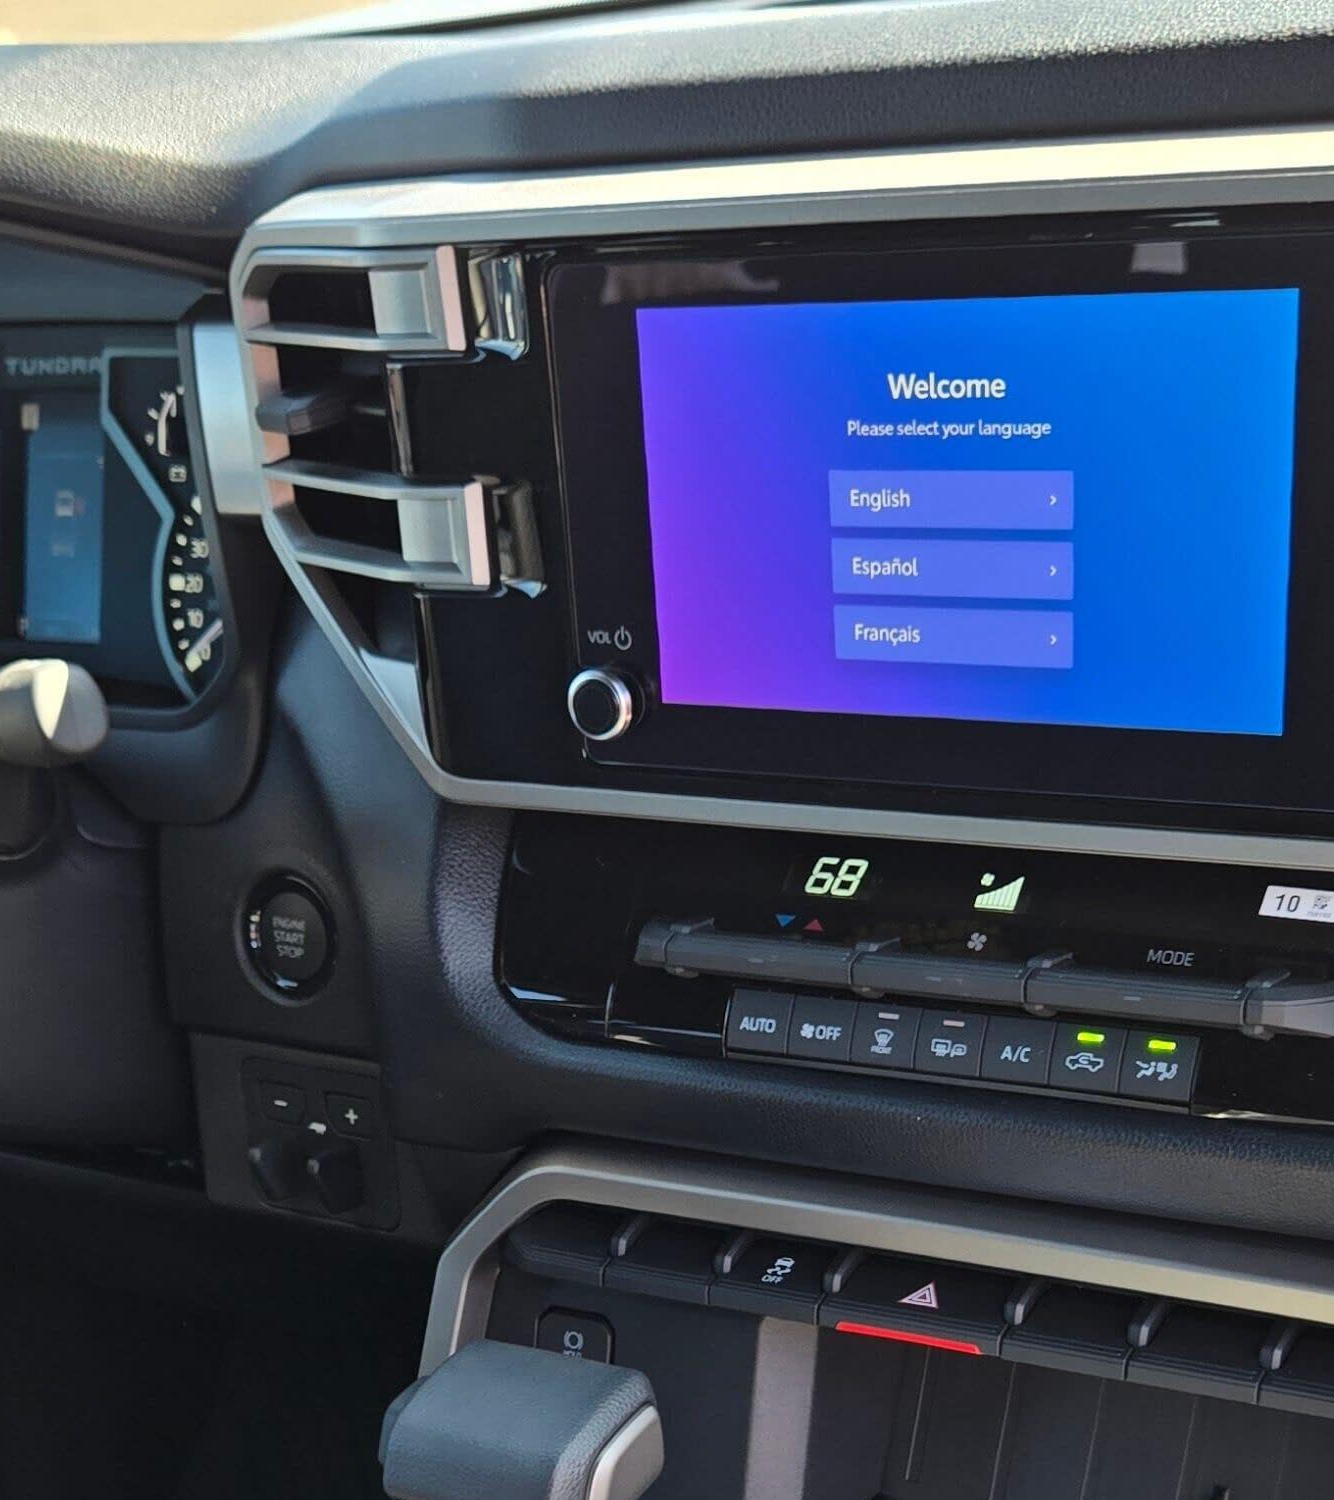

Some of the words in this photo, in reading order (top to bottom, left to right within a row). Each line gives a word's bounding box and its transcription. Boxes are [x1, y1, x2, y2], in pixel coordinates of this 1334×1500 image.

[5, 357, 104, 376] TUNDRA
[887, 372, 1006, 400] Welcome
[846, 420, 893, 436] Please
[897, 419, 939, 436] select
[942, 422, 975, 439] your
[978, 419, 1052, 439] language
[850, 489, 911, 512] English
[852, 556, 918, 579] Español
[587, 630, 612, 644] VOL
[854, 623, 920, 647] Français
[804, 856, 869, 896] 68
[1275, 894, 1301, 912] 10
[273, 930, 305, 945] START
[276, 945, 305, 958] STOP
[1146, 949, 1195, 967] MODE
[739, 1016, 777, 1034] AUTO
[815, 1025, 843, 1041] OFF
[1000, 1045, 1031, 1063] A/C
[761, 1274, 783, 1284] OFF
